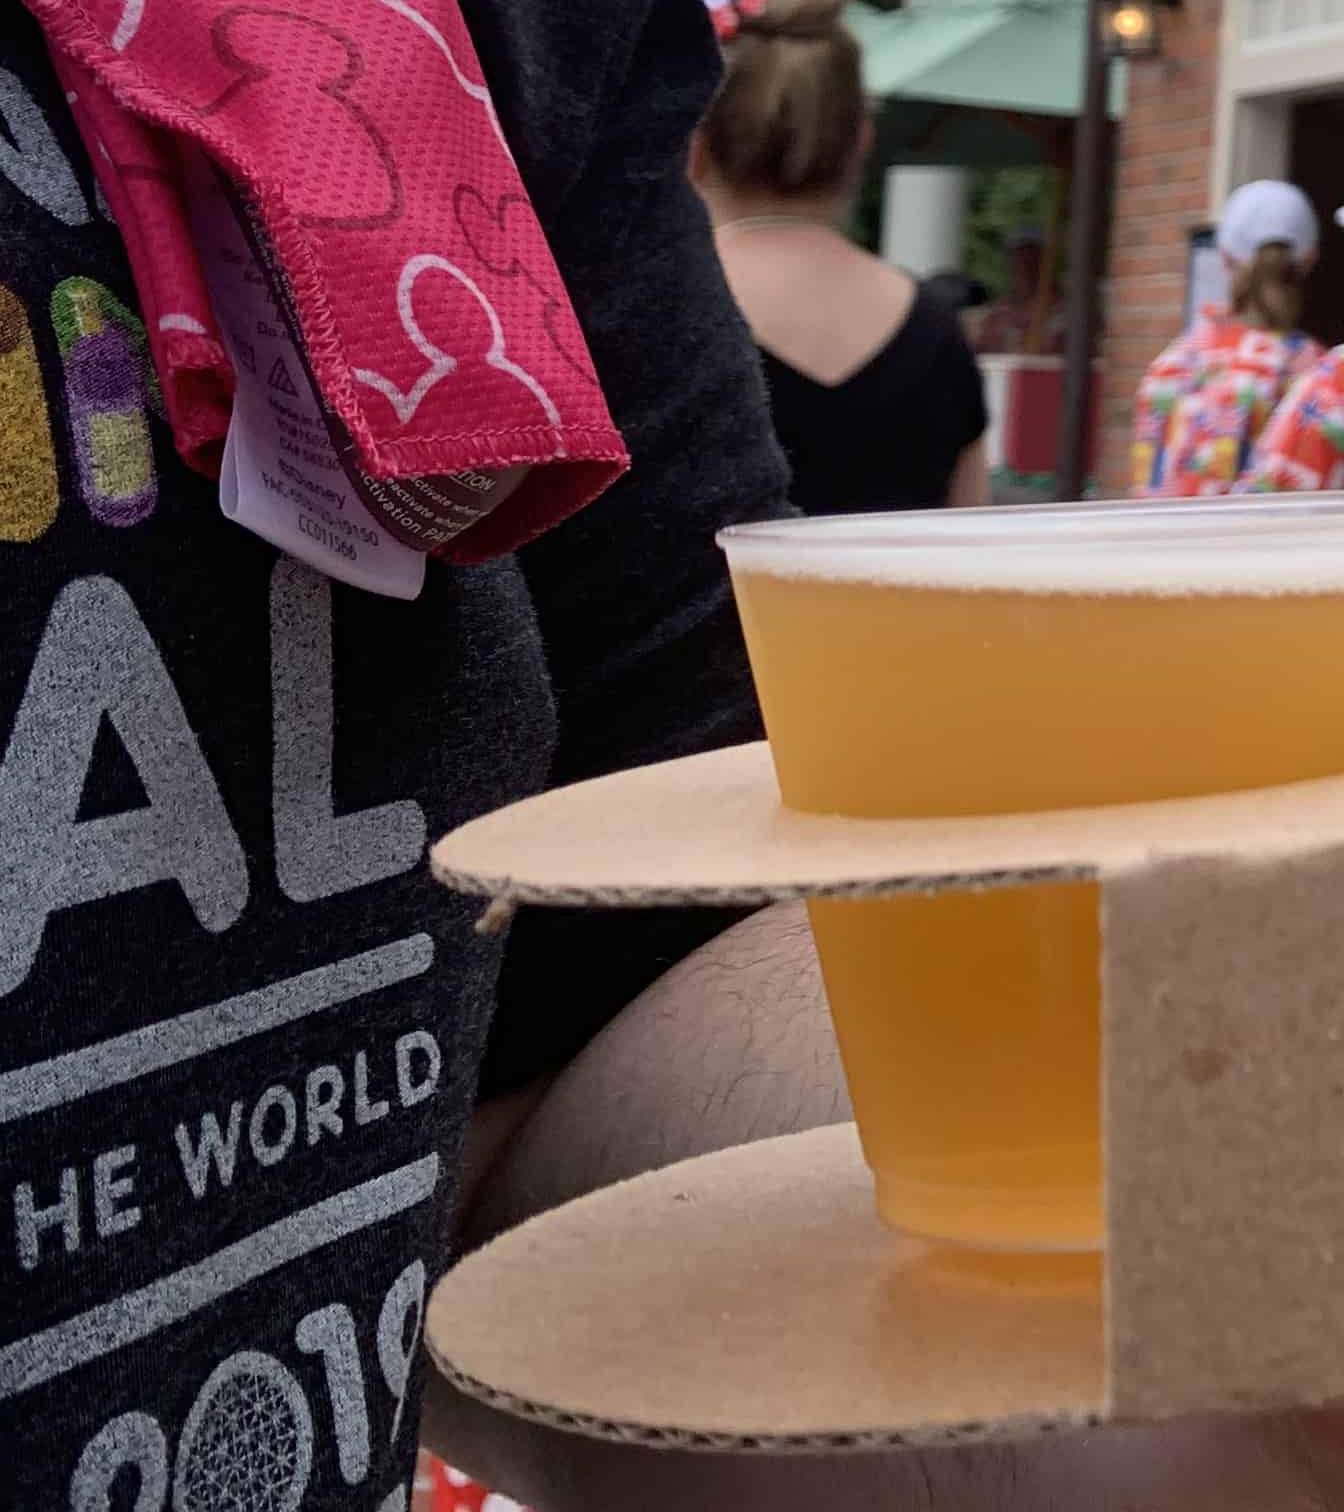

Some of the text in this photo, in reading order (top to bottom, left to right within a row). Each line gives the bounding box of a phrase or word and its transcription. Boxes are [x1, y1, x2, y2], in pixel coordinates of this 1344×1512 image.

[360, 469, 422, 535] ctivation
[0, 552, 427, 999] AL
[13, 1030, 441, 1271] HE WORLD
